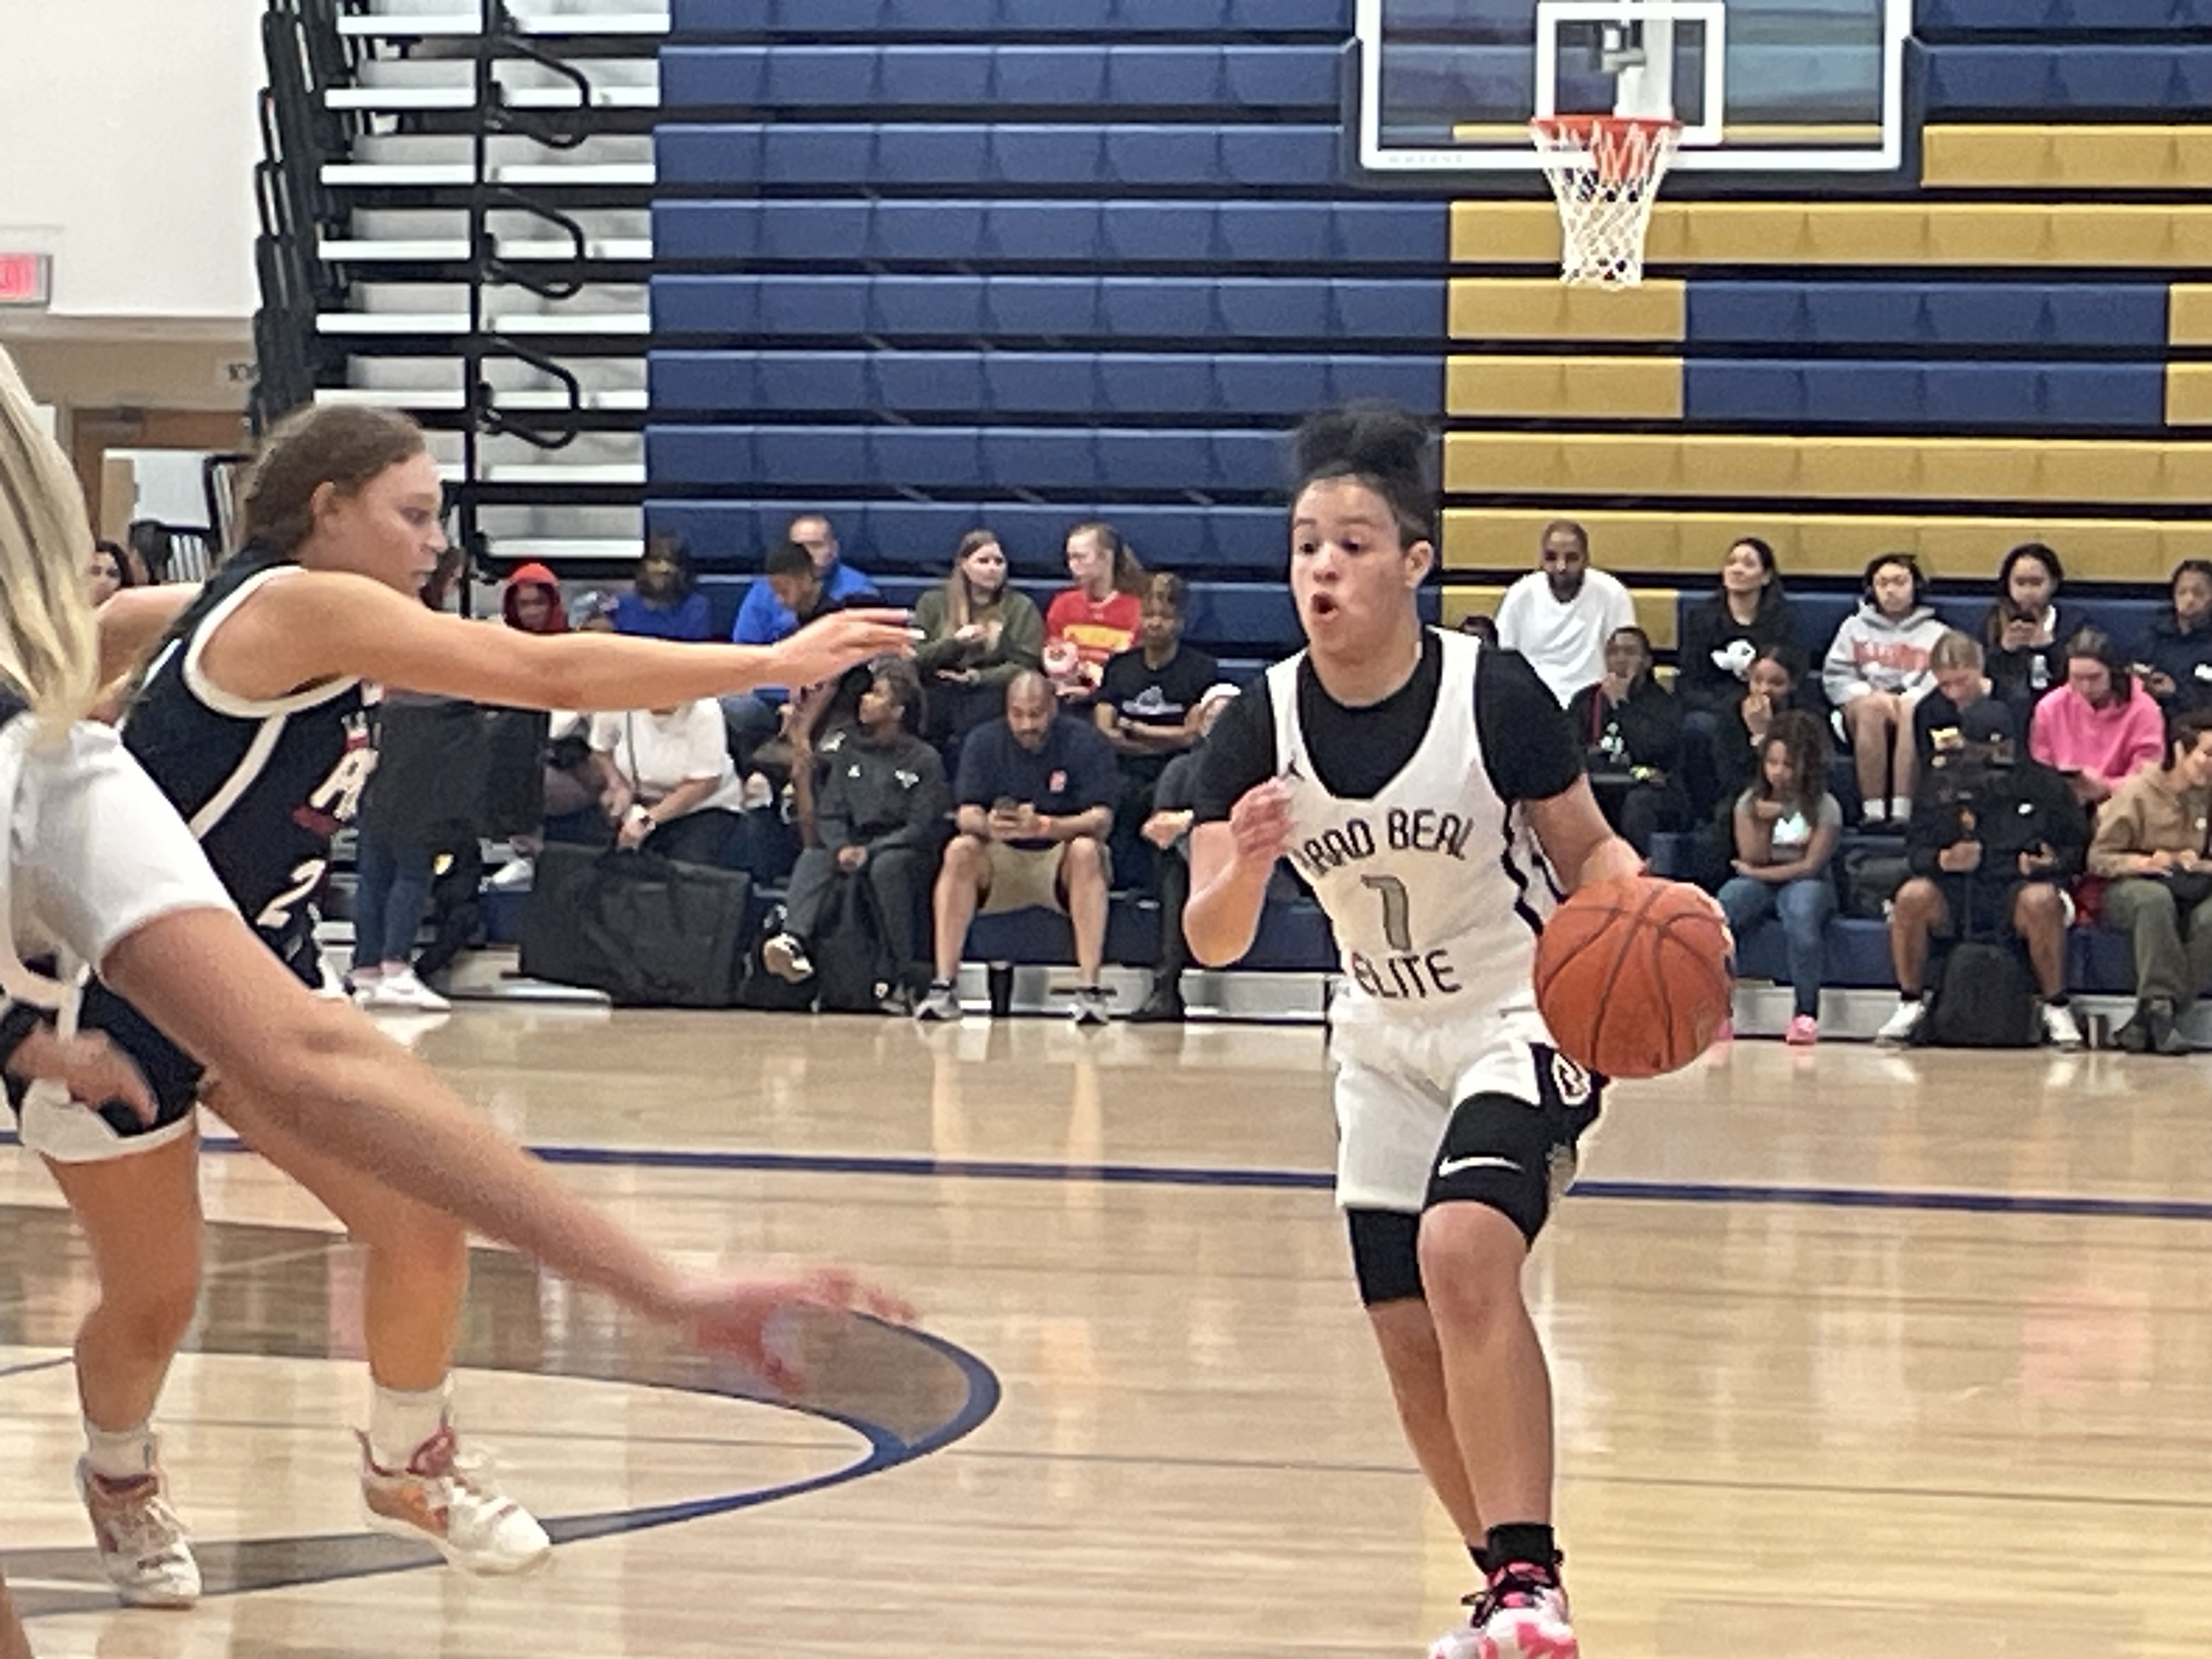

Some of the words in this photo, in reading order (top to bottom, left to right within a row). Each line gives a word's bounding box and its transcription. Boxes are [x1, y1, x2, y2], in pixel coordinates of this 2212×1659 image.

[1387, 808, 1474, 860] BEAL
[256, 858, 327, 928] 2
[1352, 949, 1463, 998] ELITE
